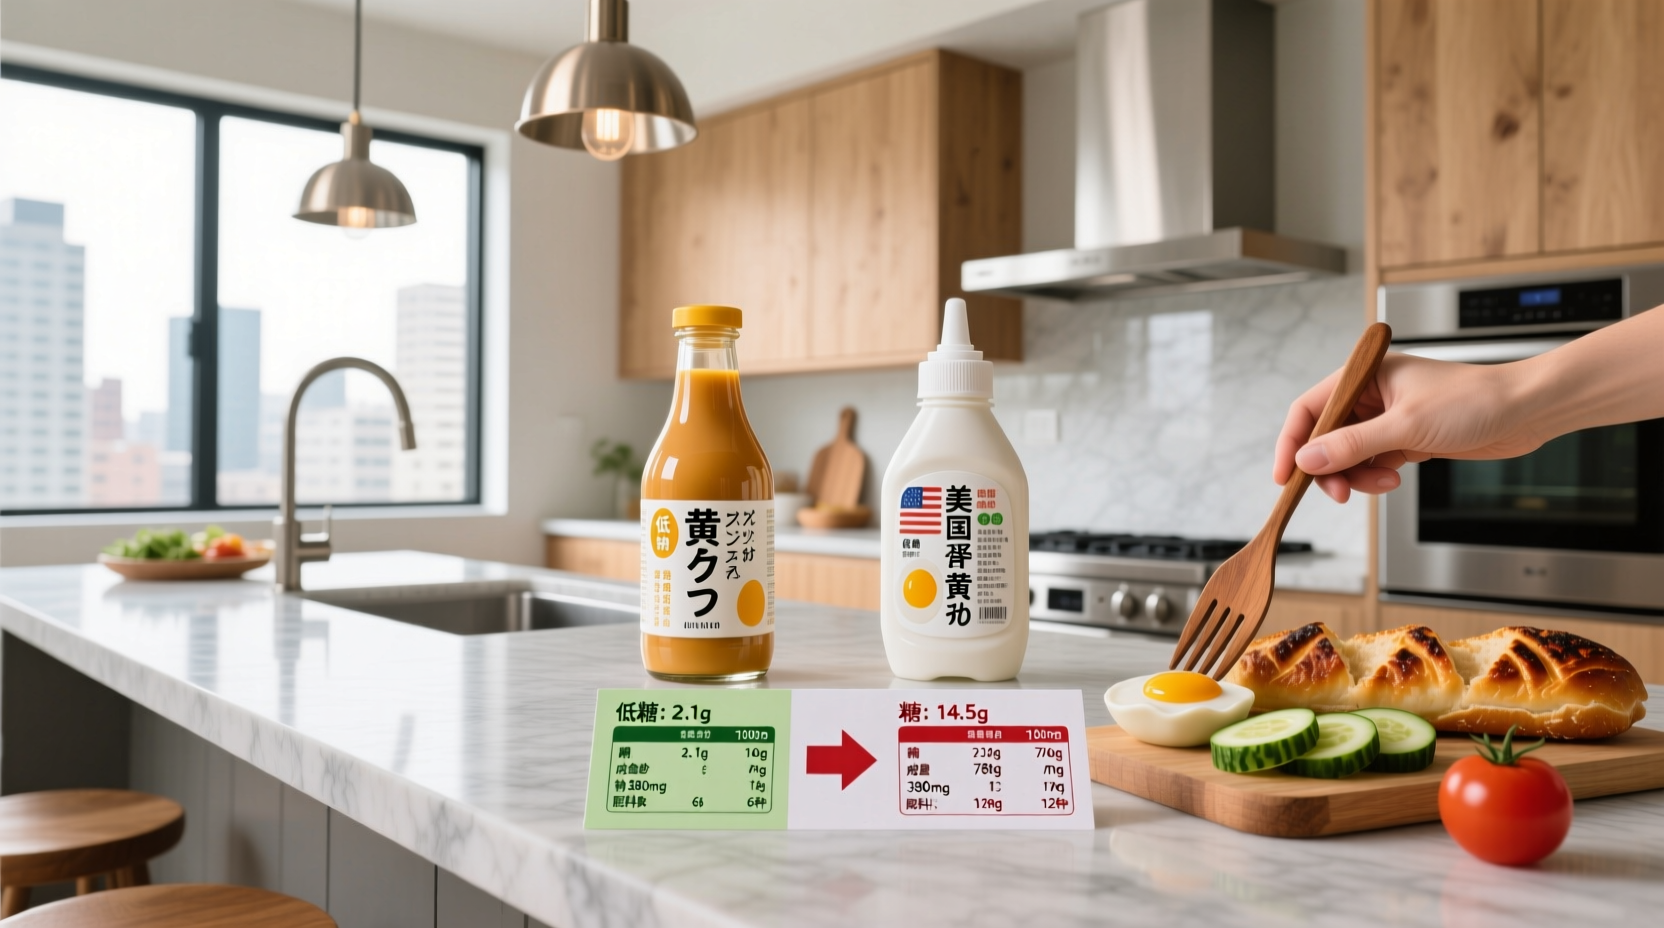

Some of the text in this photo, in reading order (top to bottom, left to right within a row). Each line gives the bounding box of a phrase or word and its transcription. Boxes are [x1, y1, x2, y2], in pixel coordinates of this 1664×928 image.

[616, 701, 711, 724] 低糖: 2.1g
[898, 701, 988, 723] 糖: 14.5g
[681, 747, 708, 761] 2.1g
